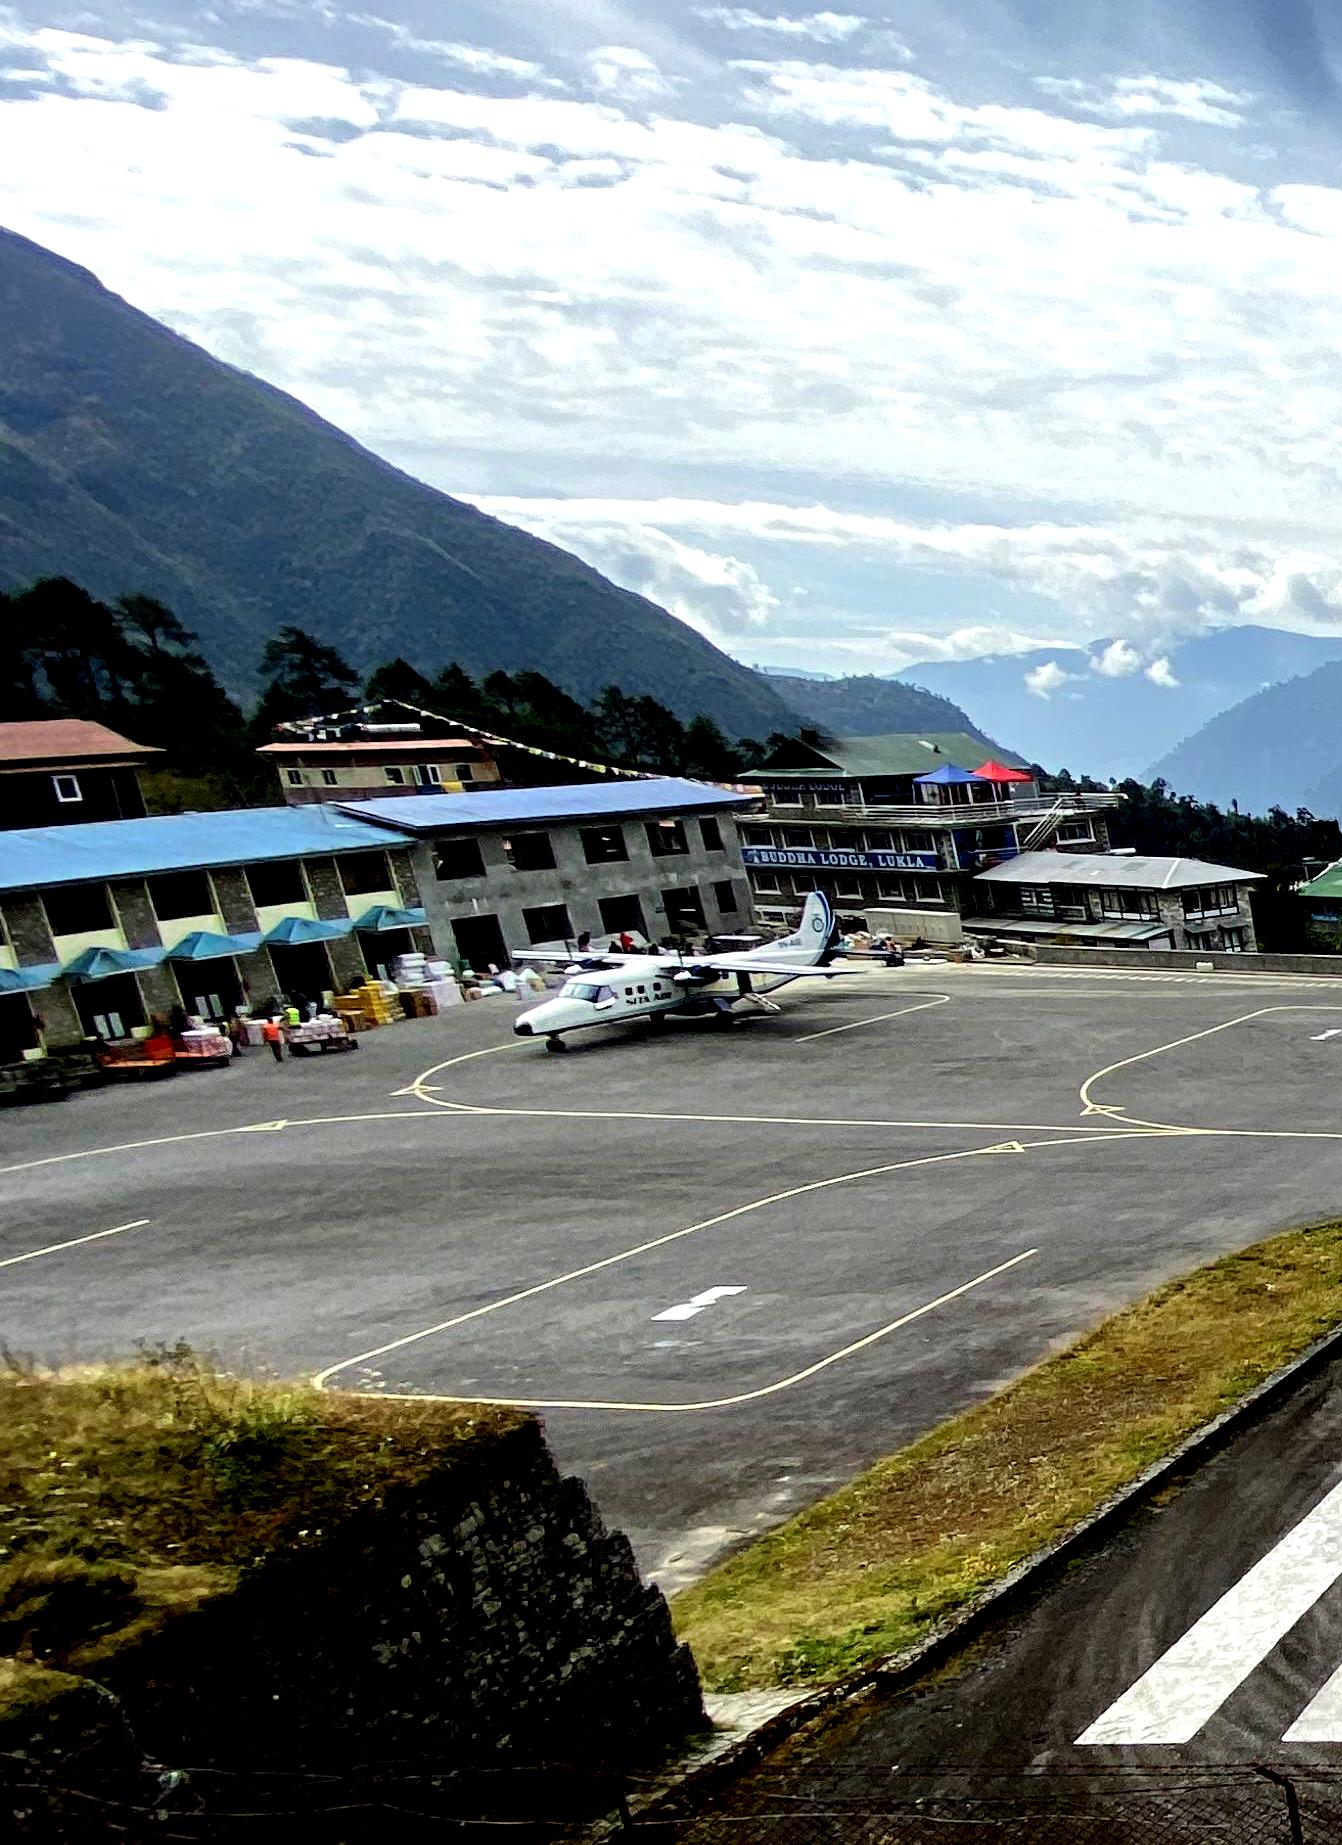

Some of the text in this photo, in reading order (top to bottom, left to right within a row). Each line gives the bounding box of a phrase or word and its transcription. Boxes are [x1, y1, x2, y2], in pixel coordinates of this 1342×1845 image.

[761, 851, 925, 868] BUDDHA LODGE, LUKLA
